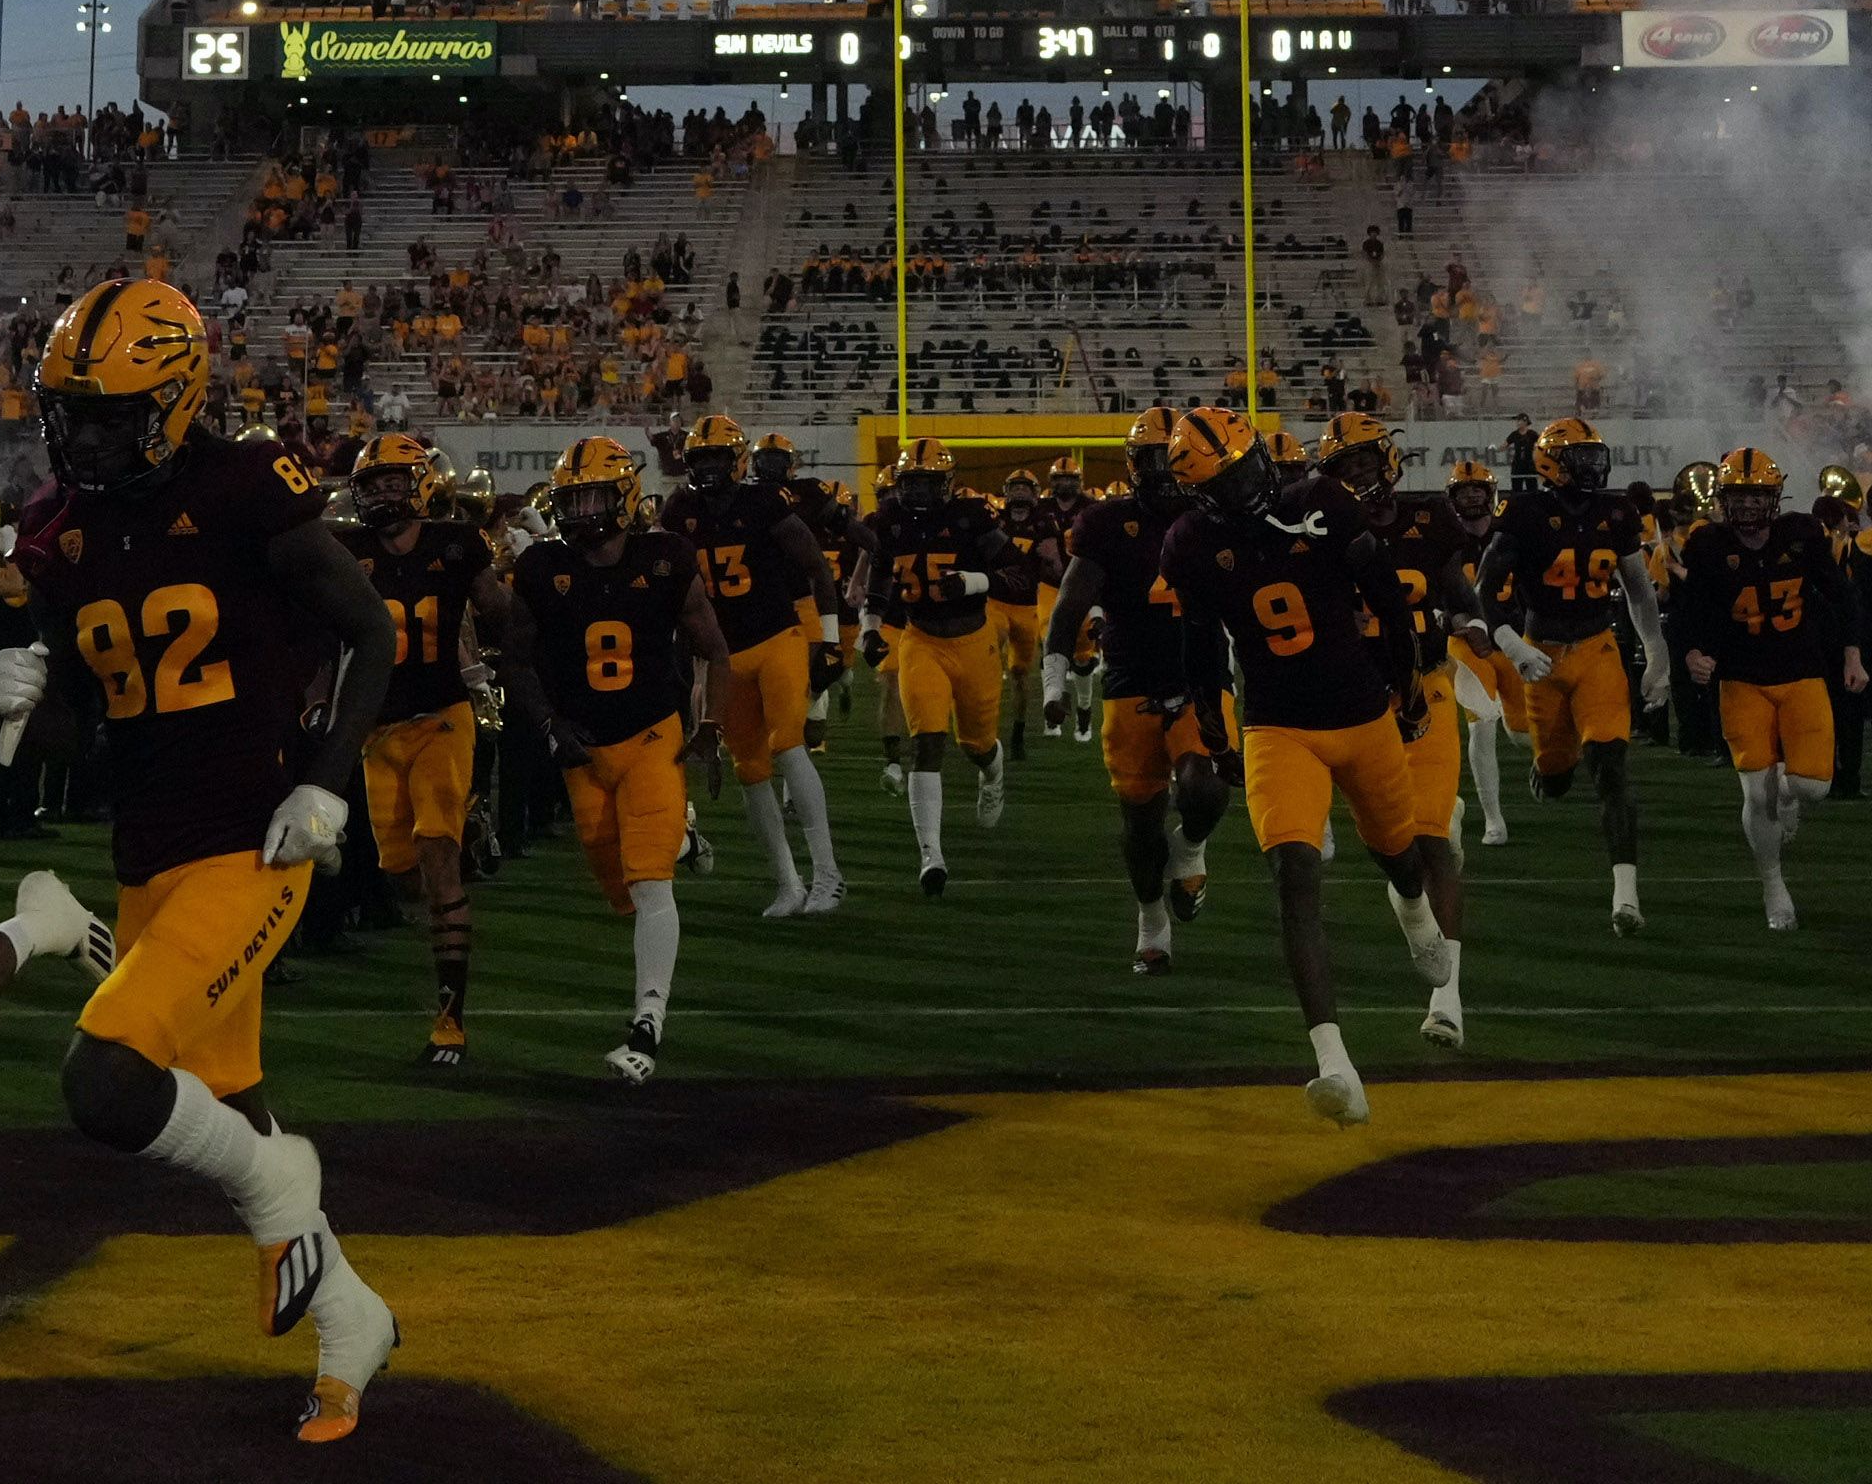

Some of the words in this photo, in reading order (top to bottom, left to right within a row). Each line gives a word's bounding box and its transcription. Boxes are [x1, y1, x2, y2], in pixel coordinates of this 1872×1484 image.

[190, 33, 242, 74] 25
[311, 29, 493, 61] Someburros
[715, 34, 746, 54] SUN
[753, 34, 813, 54] DEVILS
[1039, 27, 1094, 59] 3:47
[696, 544, 753, 598] 13
[893, 552, 958, 603] 35
[1252, 581, 1315, 657] 9
[1731, 576, 1806, 636] 43
[76, 582, 236, 720] 82
[584, 620, 635, 691] 8
[207, 959, 240, 1007] SUN
[243, 885, 294, 965] DEVILS
